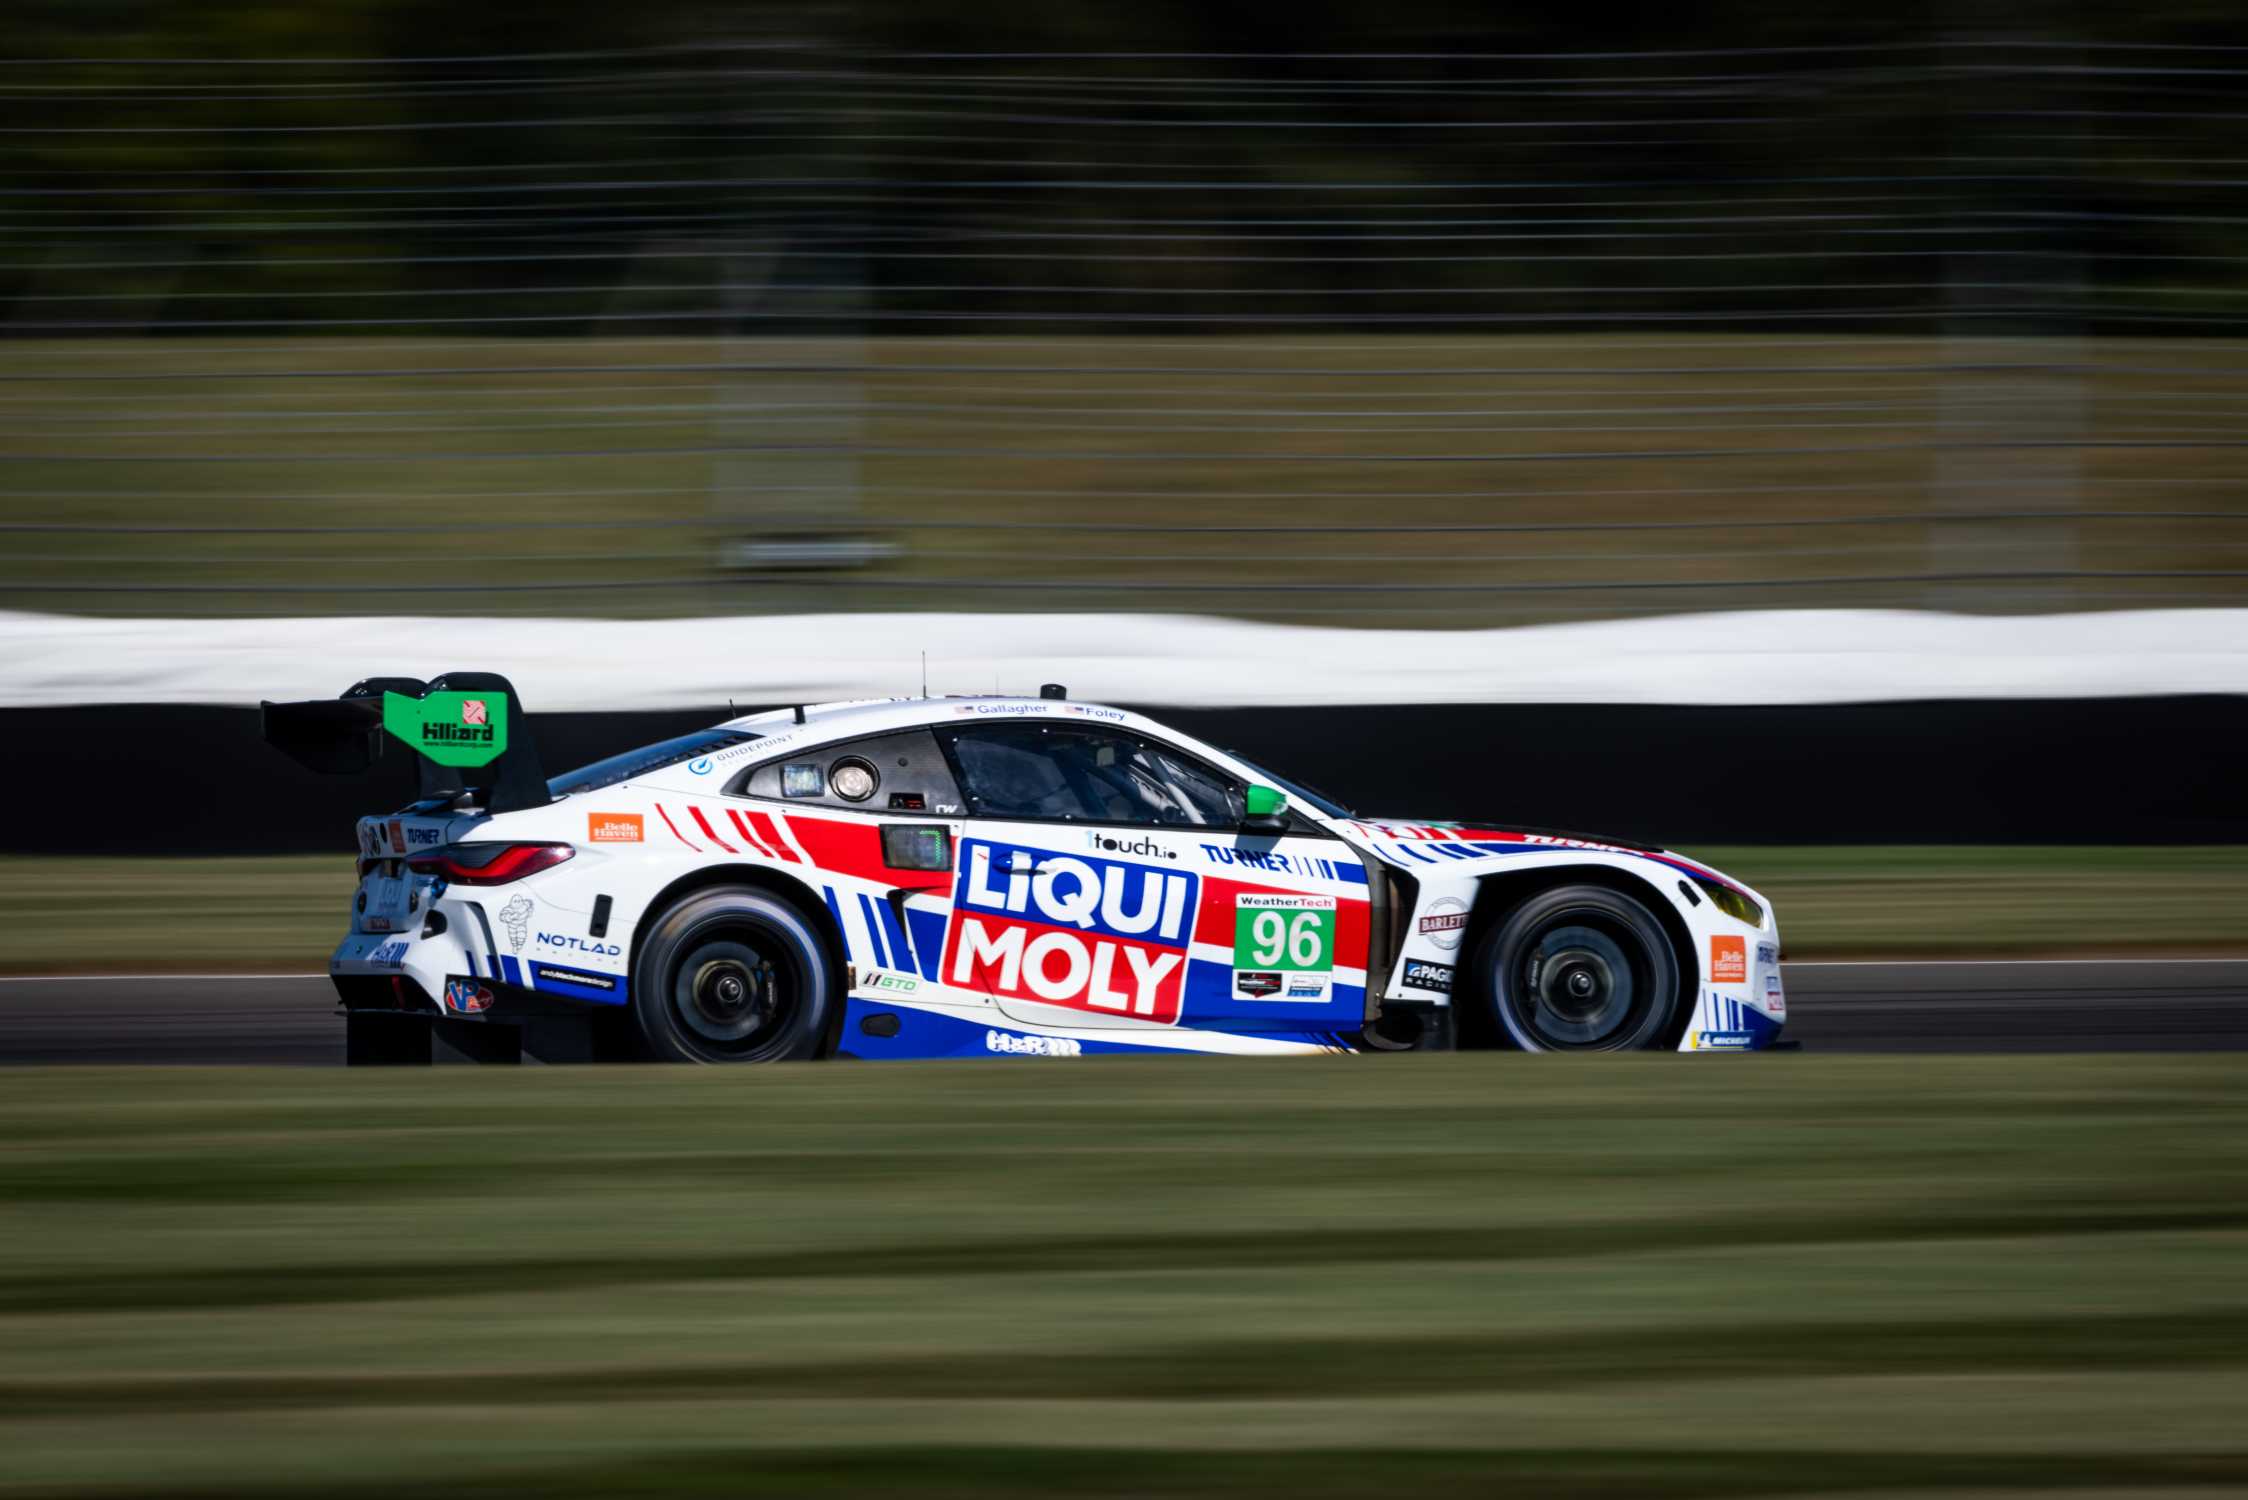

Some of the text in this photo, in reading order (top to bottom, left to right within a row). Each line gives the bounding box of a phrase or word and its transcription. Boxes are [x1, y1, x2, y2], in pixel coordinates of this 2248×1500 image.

[977, 703, 1048, 716] Gallagher
[1086, 706, 1126, 721] Foley
[423, 722, 494, 740] Hilliard
[716, 734, 793, 761] GUIDEPOINT
[406, 828, 440, 844] TURNER
[1200, 844, 1292, 873] TURNER
[1241, 897, 1333, 907] WeatherTech
[537, 931, 621, 956] NOTLAD
[1252, 910, 1322, 967] 96
[952, 917, 1184, 1015] MOLY
[448, 979, 480, 1011] VP
